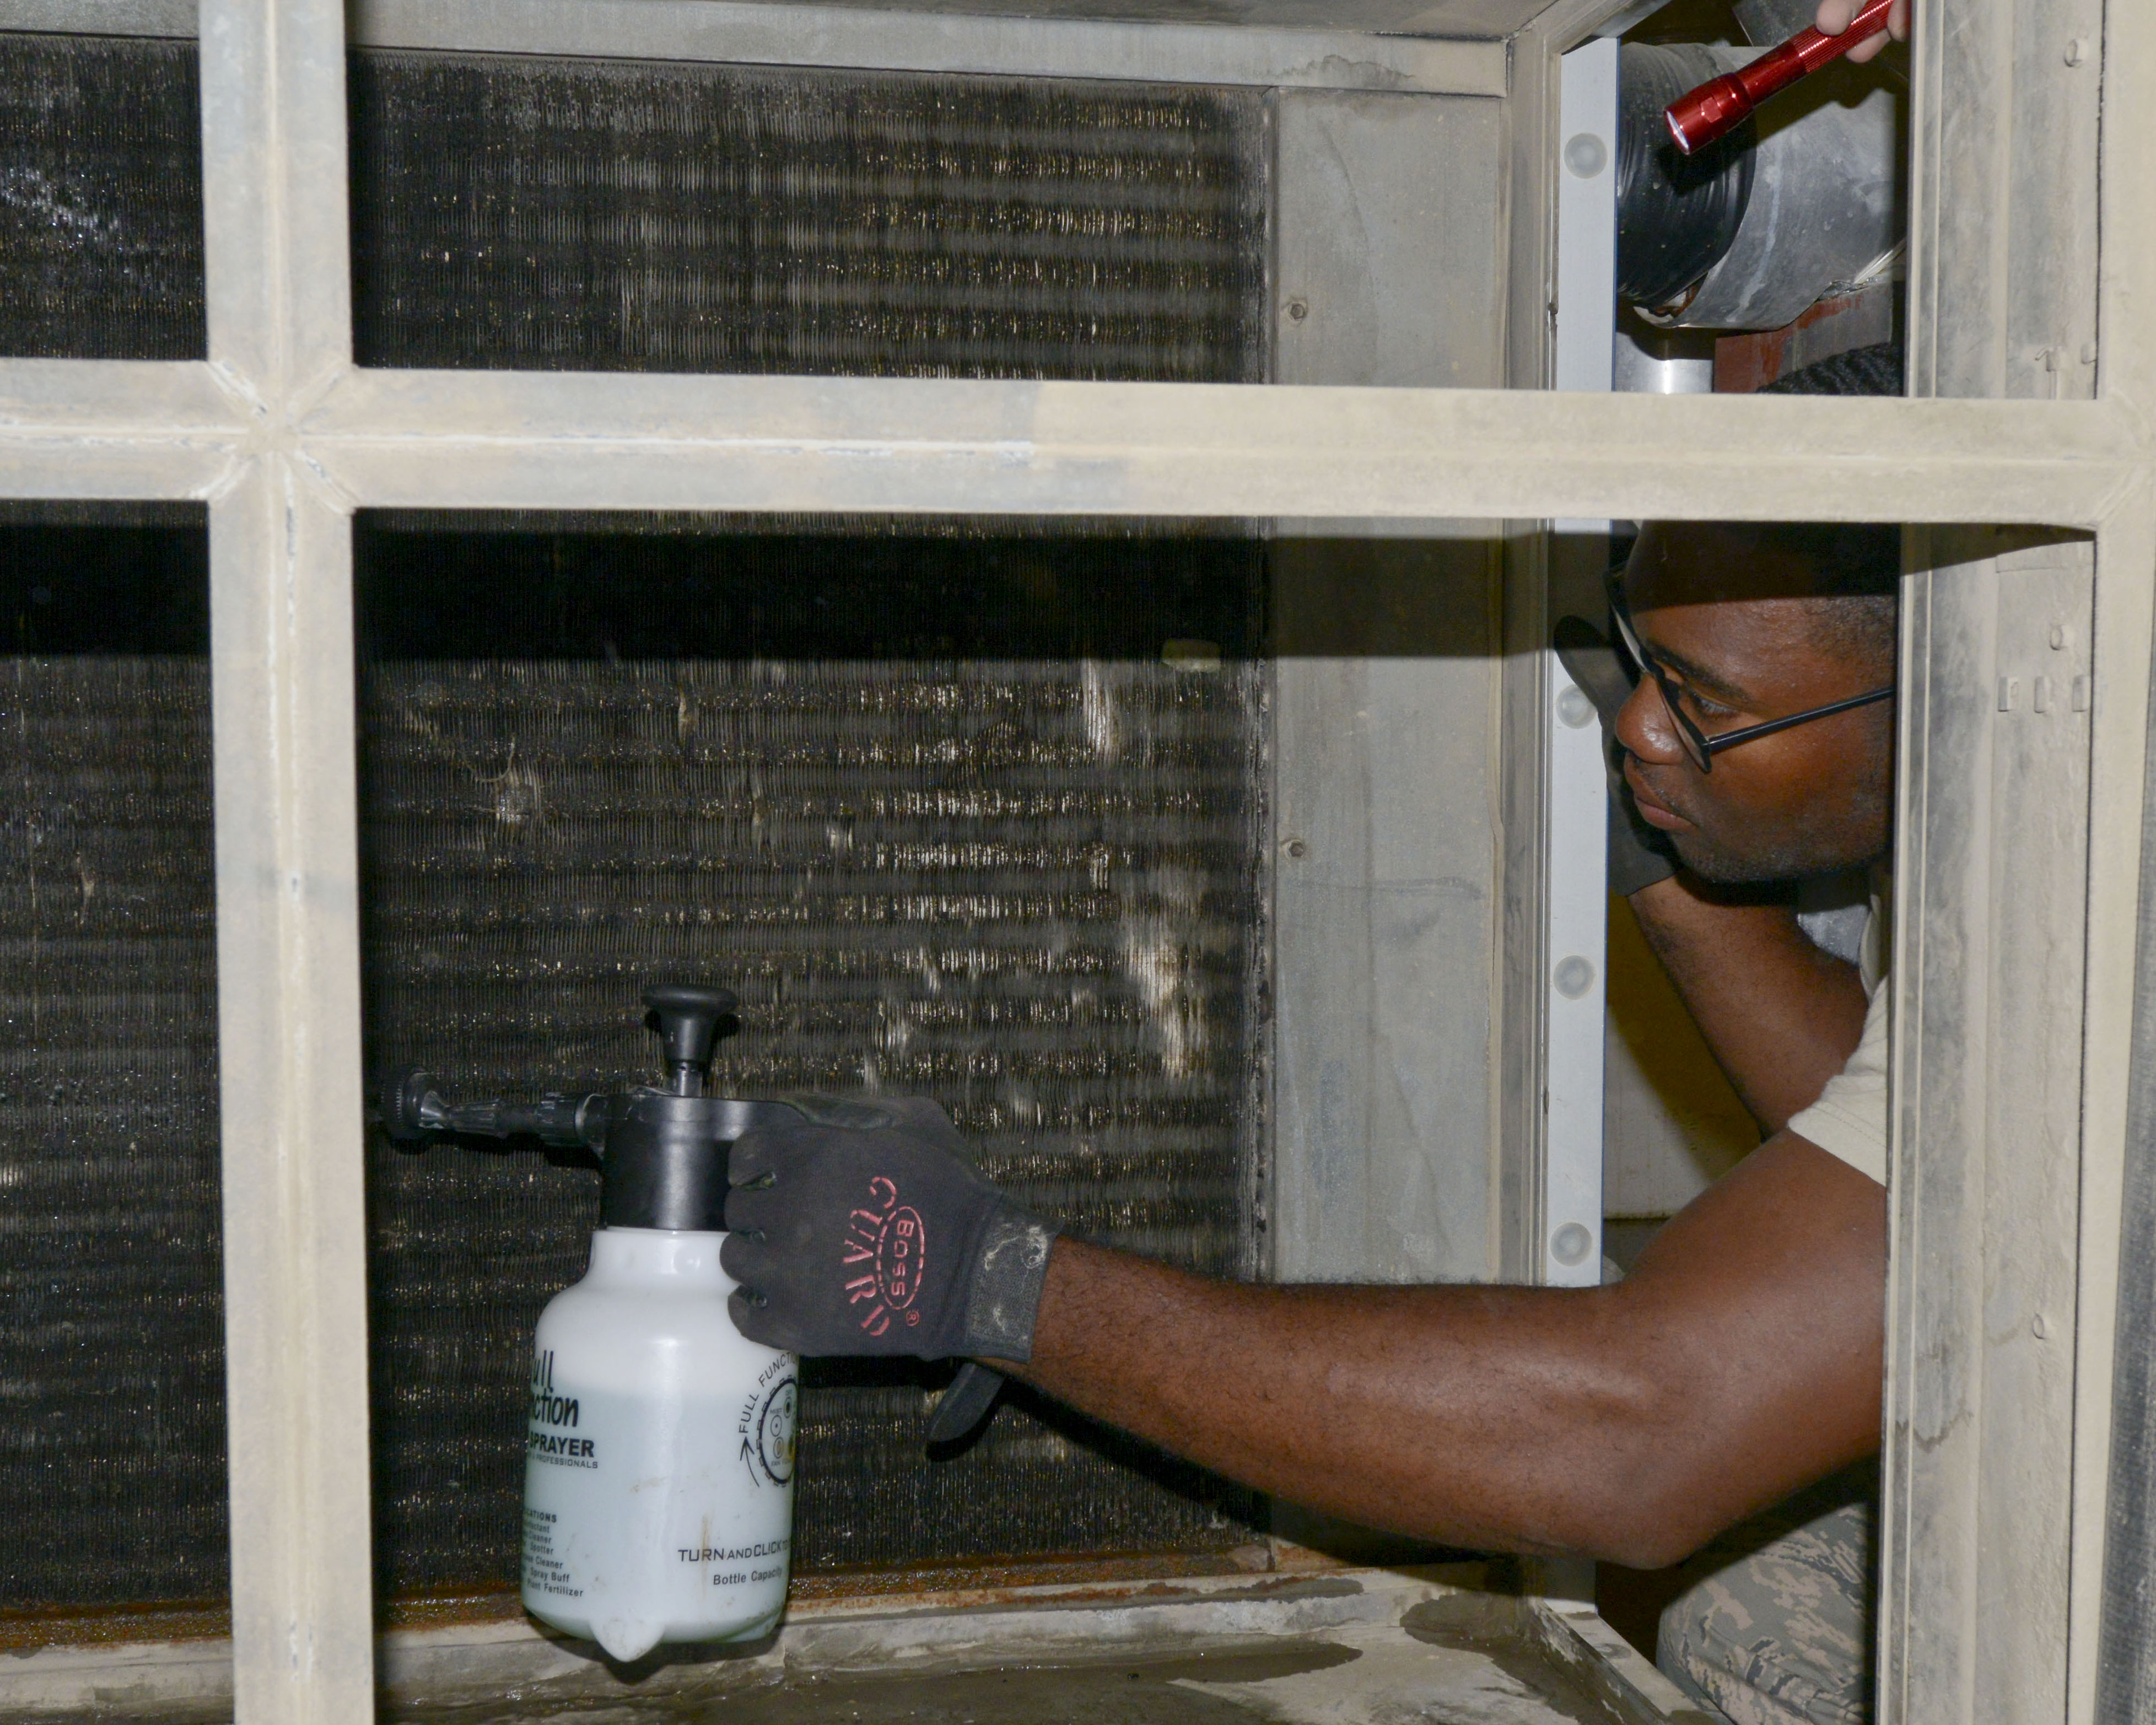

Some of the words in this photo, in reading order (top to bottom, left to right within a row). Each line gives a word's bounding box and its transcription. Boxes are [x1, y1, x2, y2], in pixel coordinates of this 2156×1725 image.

[890, 1219, 914, 1296] BOSS
[532, 1350, 554, 1388] ull
[532, 1387, 579, 1427] ction
[739, 1393, 759, 1433] FULL
[529, 1431, 595, 1458] SPRAYER
[536, 1455, 598, 1469] PROFESSIONALS
[525, 1509, 557, 1524] CATIONS
[535, 1556, 563, 1568] Cleaner
[551, 1572, 569, 1582] Buff
[713, 1572, 747, 1586] Bottle
[544, 1583, 584, 1596] Fertilizer
